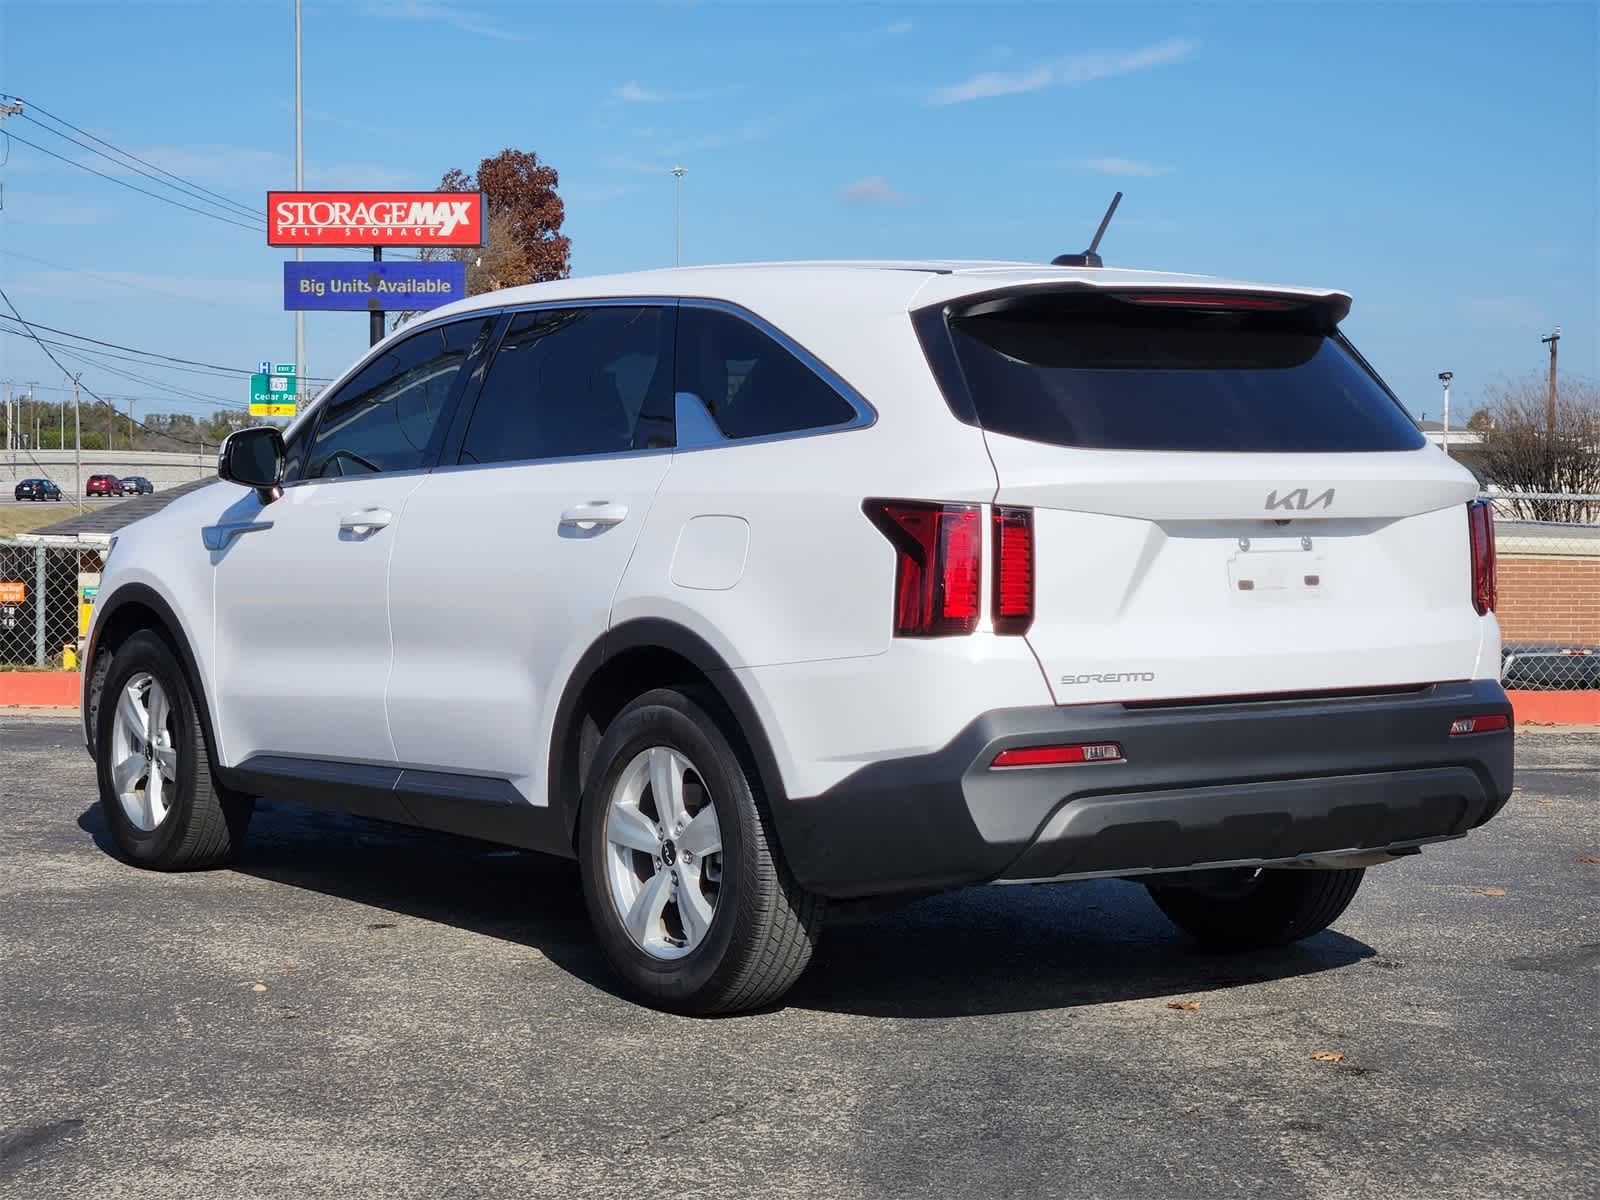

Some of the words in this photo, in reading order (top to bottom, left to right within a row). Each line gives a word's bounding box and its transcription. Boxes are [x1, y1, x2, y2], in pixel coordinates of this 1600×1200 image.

[277, 227, 324, 236] SELF
[345, 227, 436, 236] STORAGE
[299, 279, 325, 296] Big
[330, 279, 372, 293] Units
[376, 279, 452, 293] Available
[254, 393, 279, 401] Cedar
[1264, 488, 1336, 510] KIA
[1060, 672, 1155, 685] SORENTO
